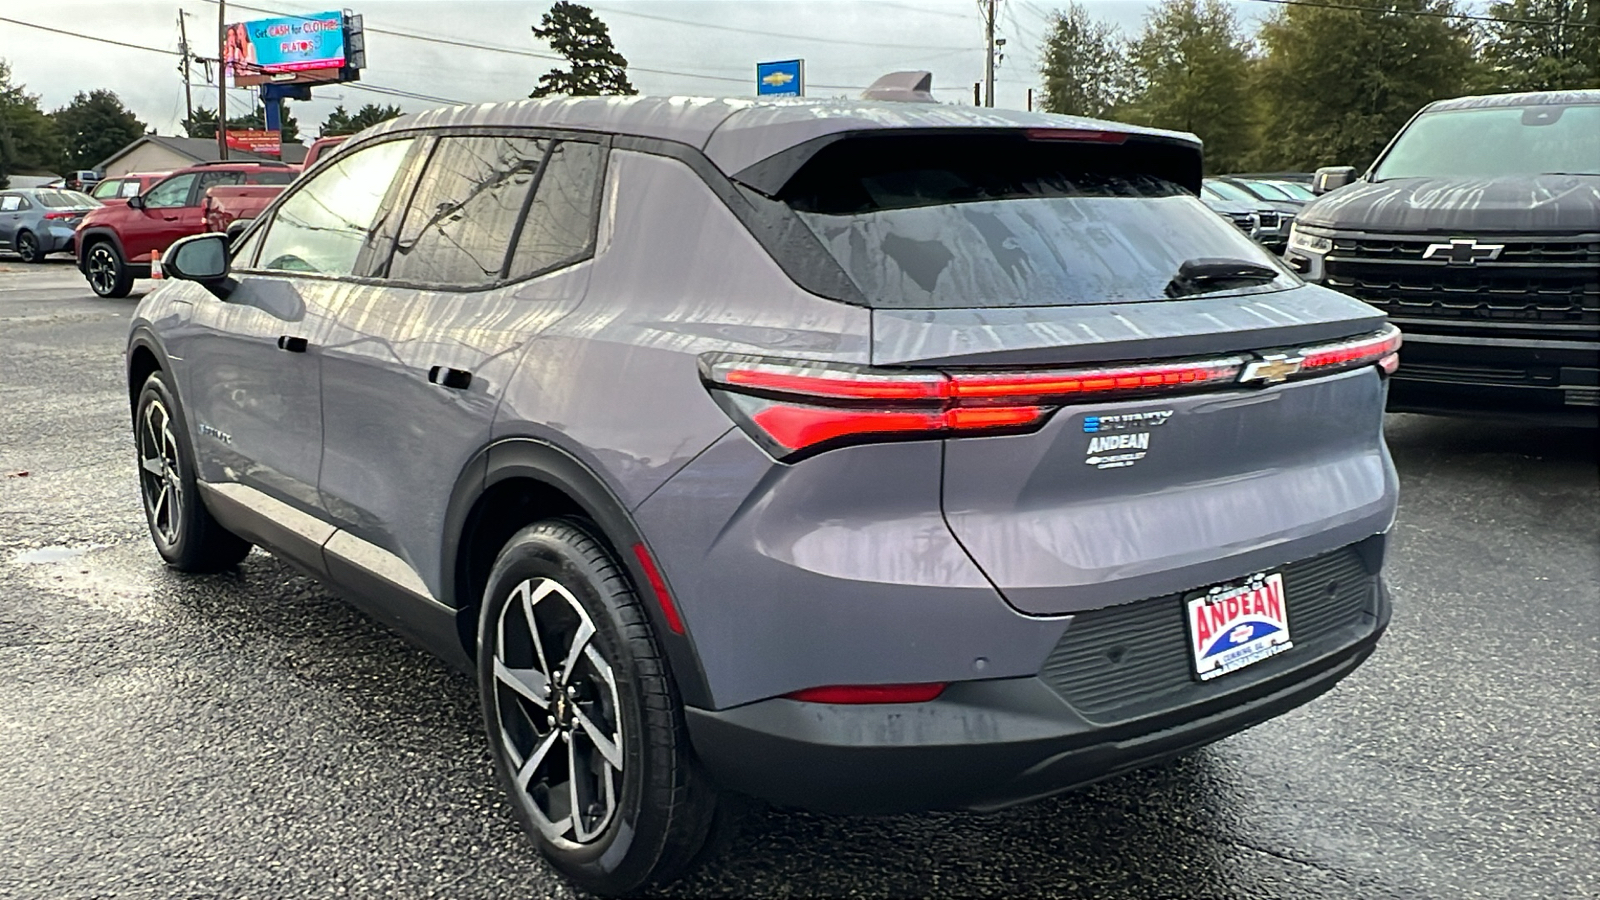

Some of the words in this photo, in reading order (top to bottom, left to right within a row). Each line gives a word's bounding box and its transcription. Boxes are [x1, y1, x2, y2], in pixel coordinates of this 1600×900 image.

[255, 28, 268, 39] Get
[269, 25, 290, 36] CASH
[291, 24, 302, 35] for
[303, 20, 338, 34] CLOTHES
[1087, 432, 1150, 455] ANDEAN
[1196, 581, 1283, 653] ANDEAN
